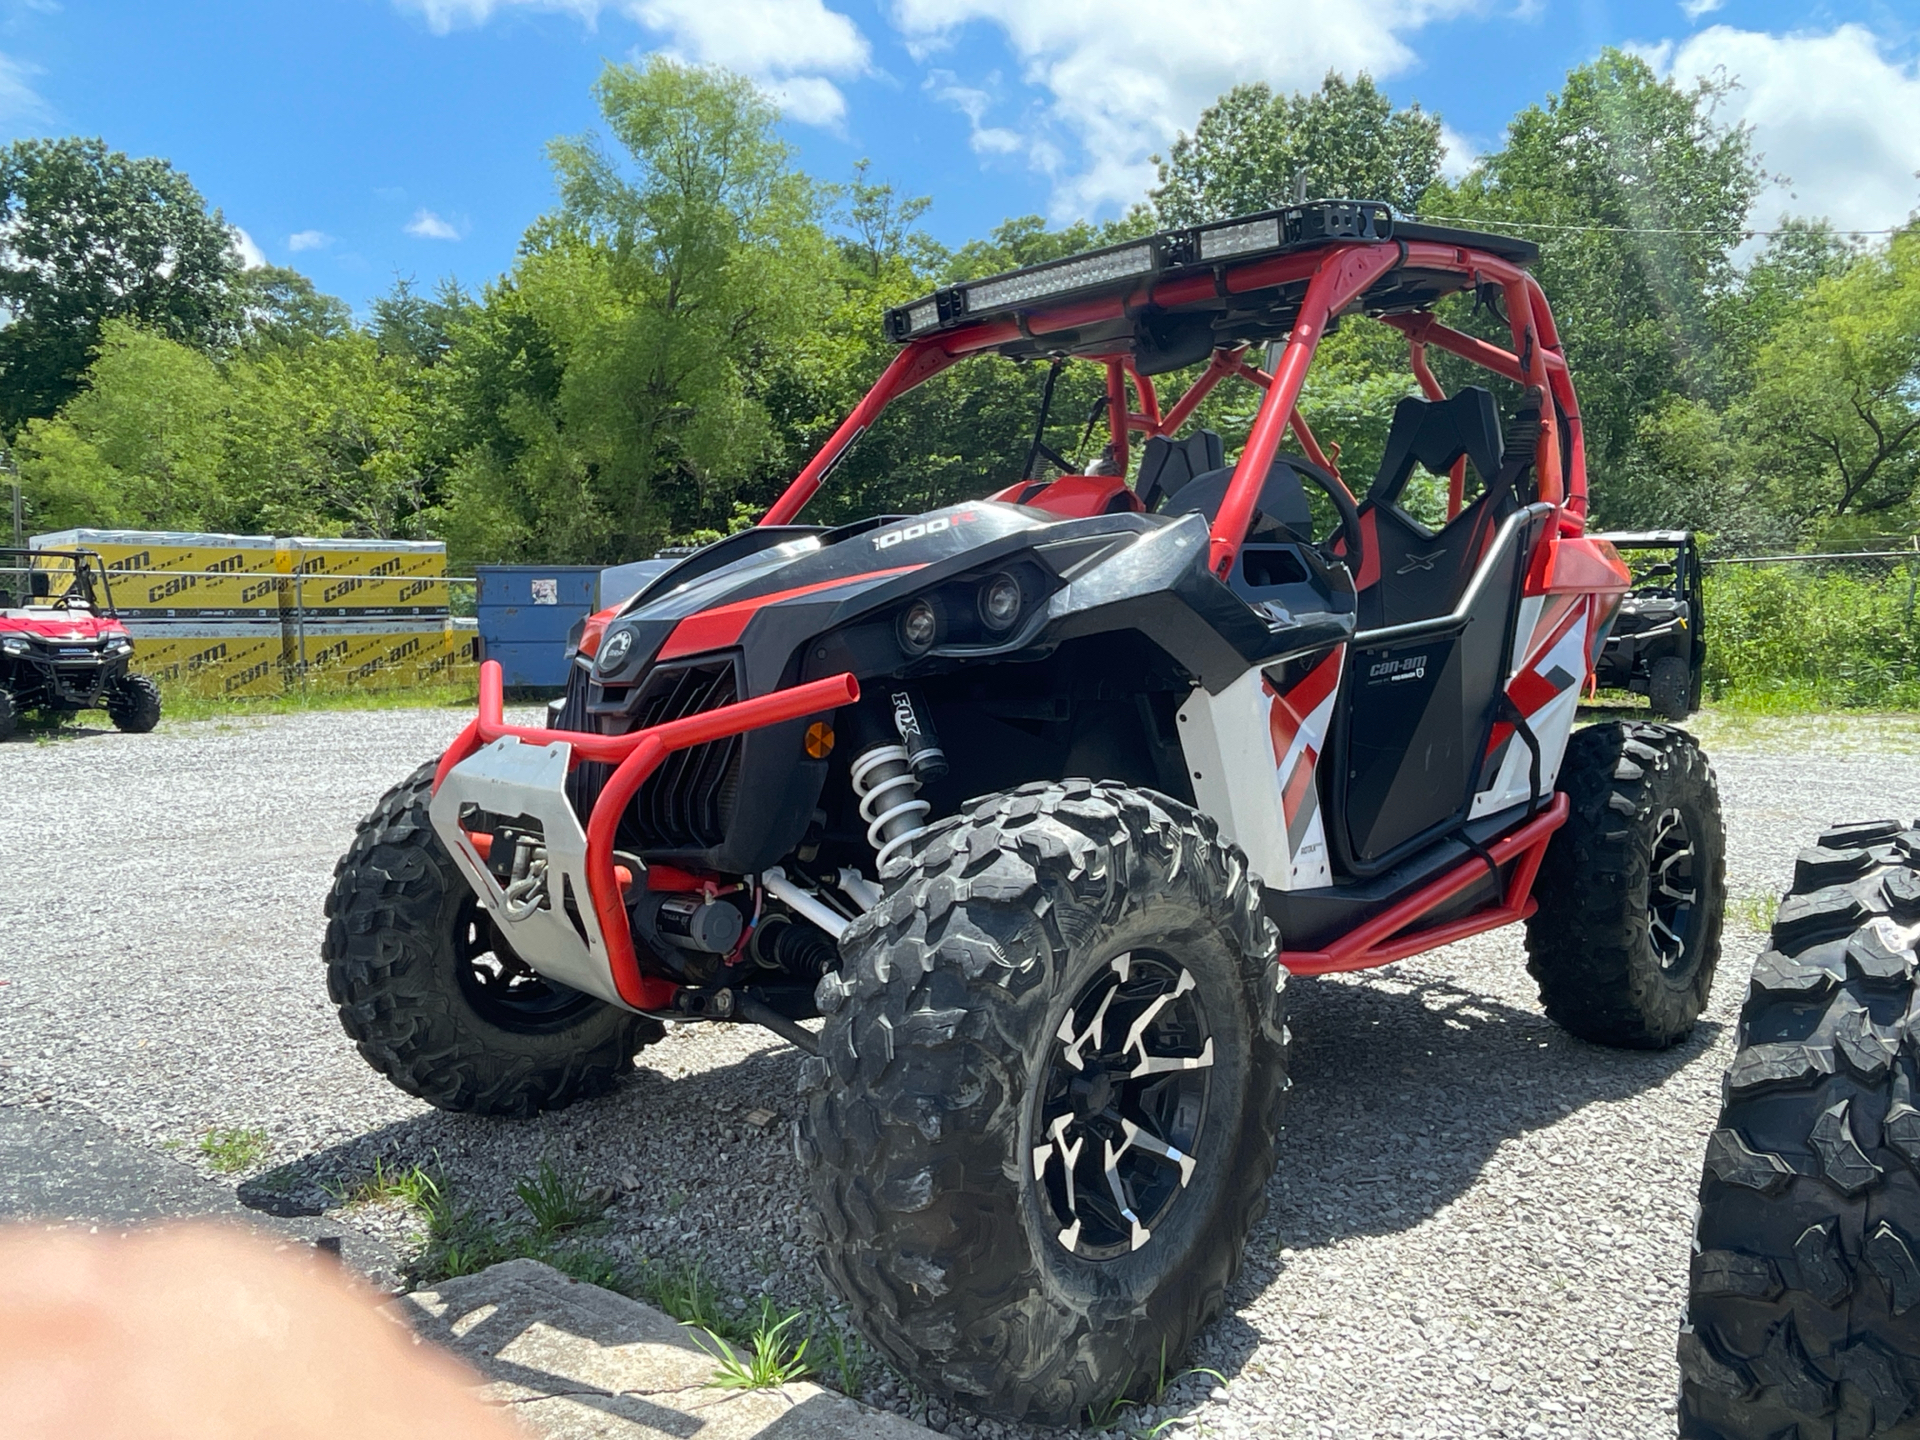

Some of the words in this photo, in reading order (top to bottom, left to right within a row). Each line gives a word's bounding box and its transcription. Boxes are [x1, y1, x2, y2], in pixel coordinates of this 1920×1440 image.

[872, 510, 978, 550] 1000R
[149, 553, 243, 603] can-am
[324, 557, 400, 602] canam
[1369, 655, 1427, 677] can-am
